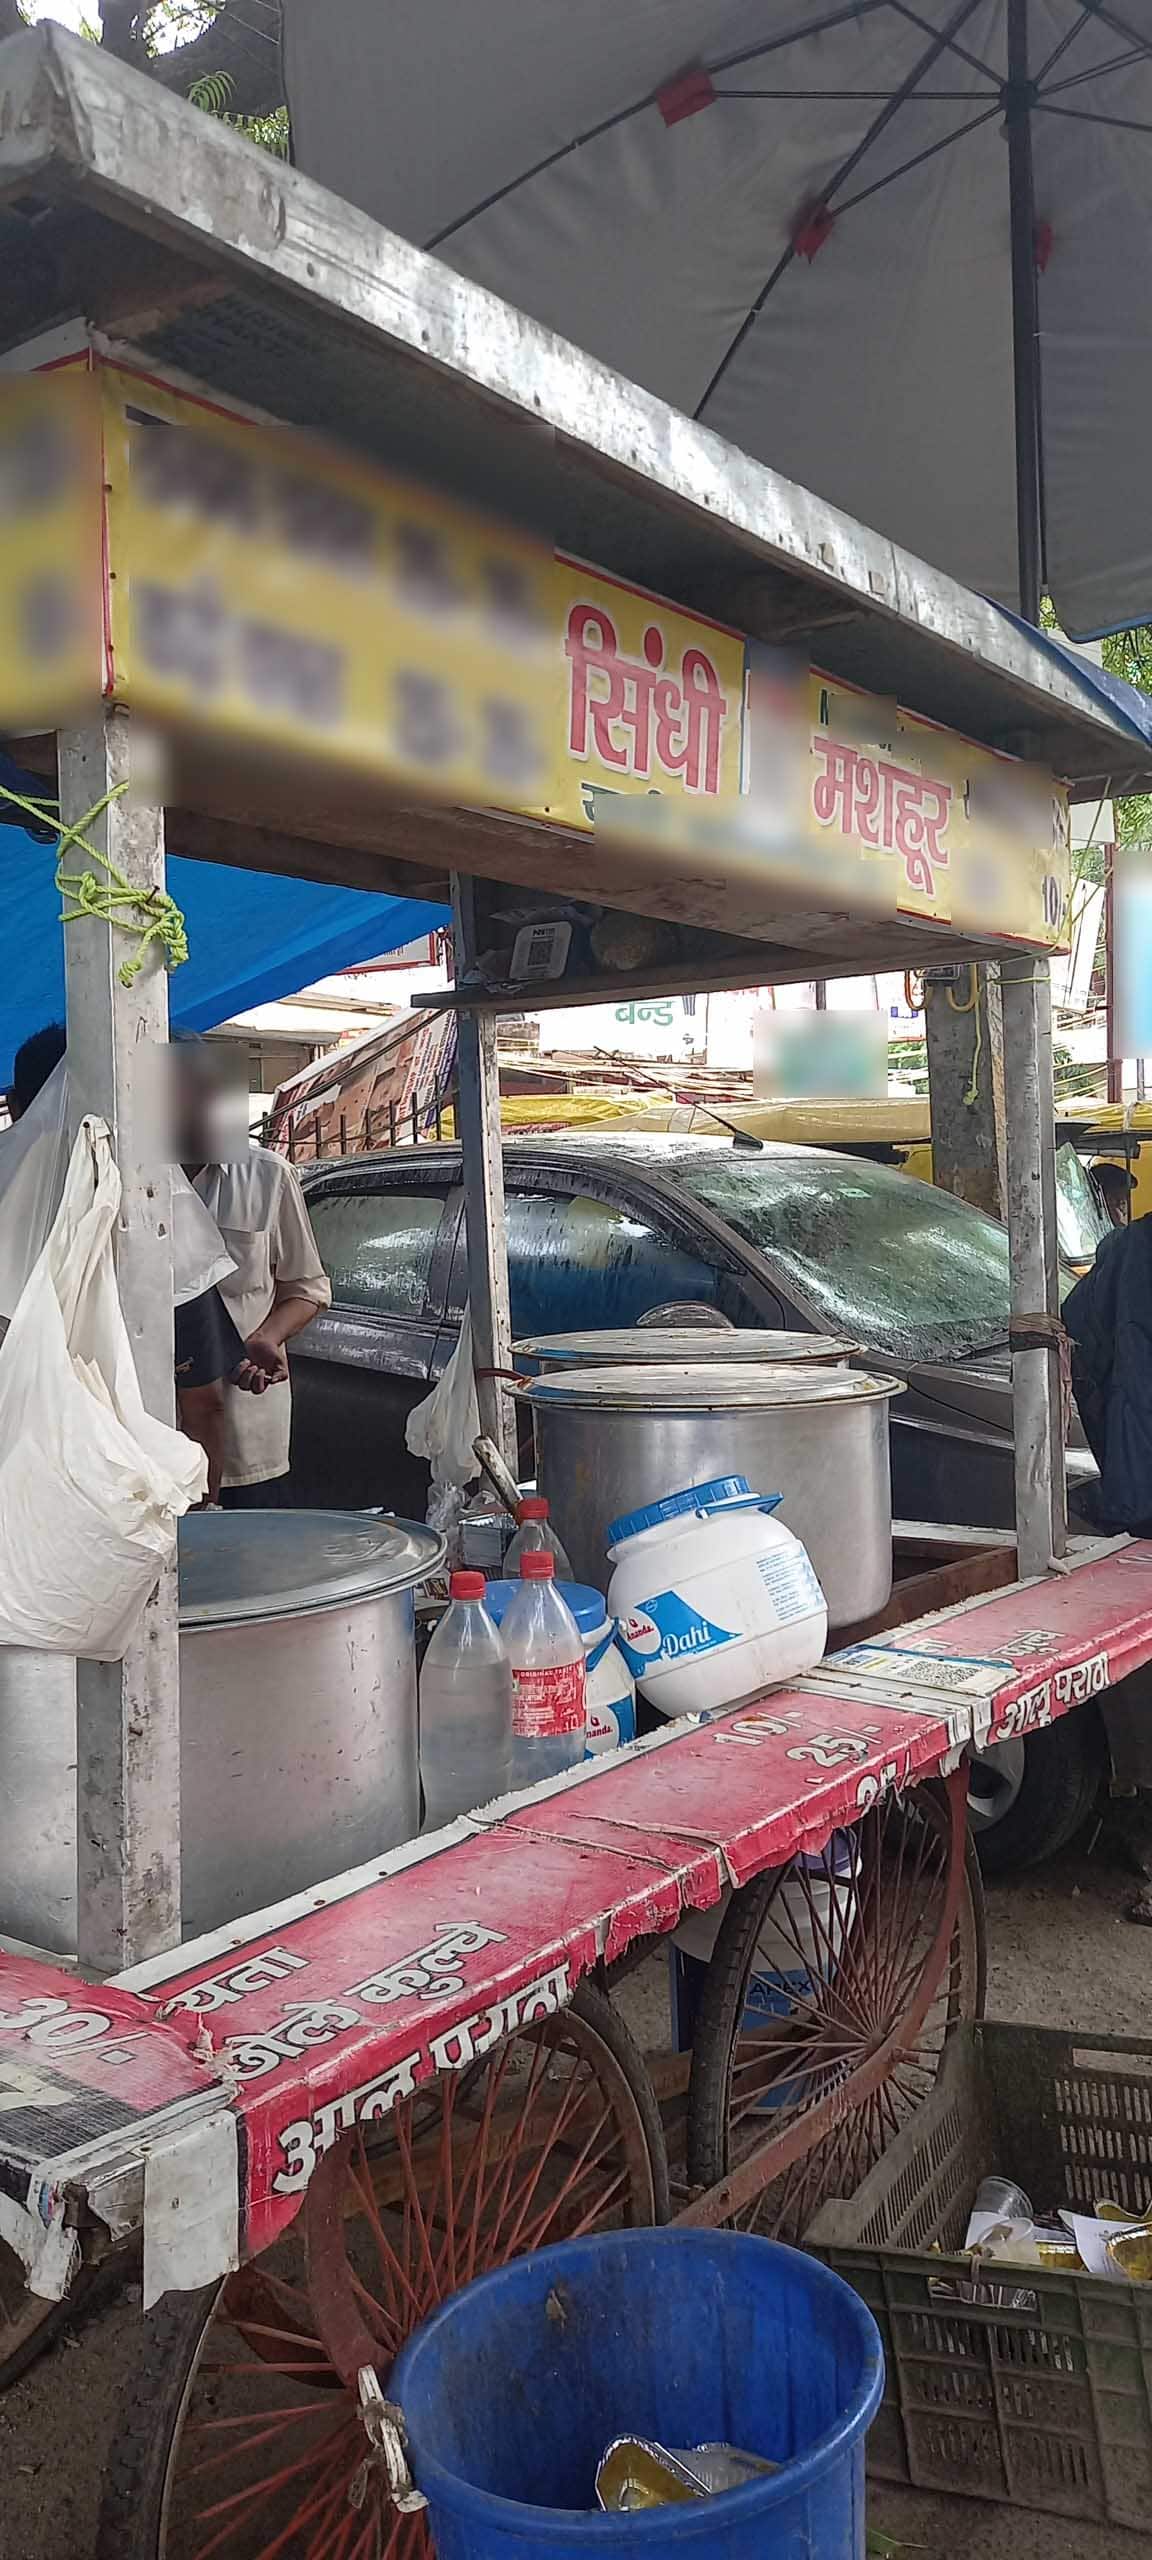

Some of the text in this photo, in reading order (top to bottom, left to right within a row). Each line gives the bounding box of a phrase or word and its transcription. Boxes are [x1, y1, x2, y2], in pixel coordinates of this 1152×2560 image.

[564, 604, 728, 795] सिंधी
[813, 735, 952, 896] मशहूर
[663, 1620, 712, 1657] Dahi
[1054, 1651, 1110, 1702] पराठा
[713, 1711, 803, 1746] 10/-
[786, 1715, 882, 1768] 25/-
